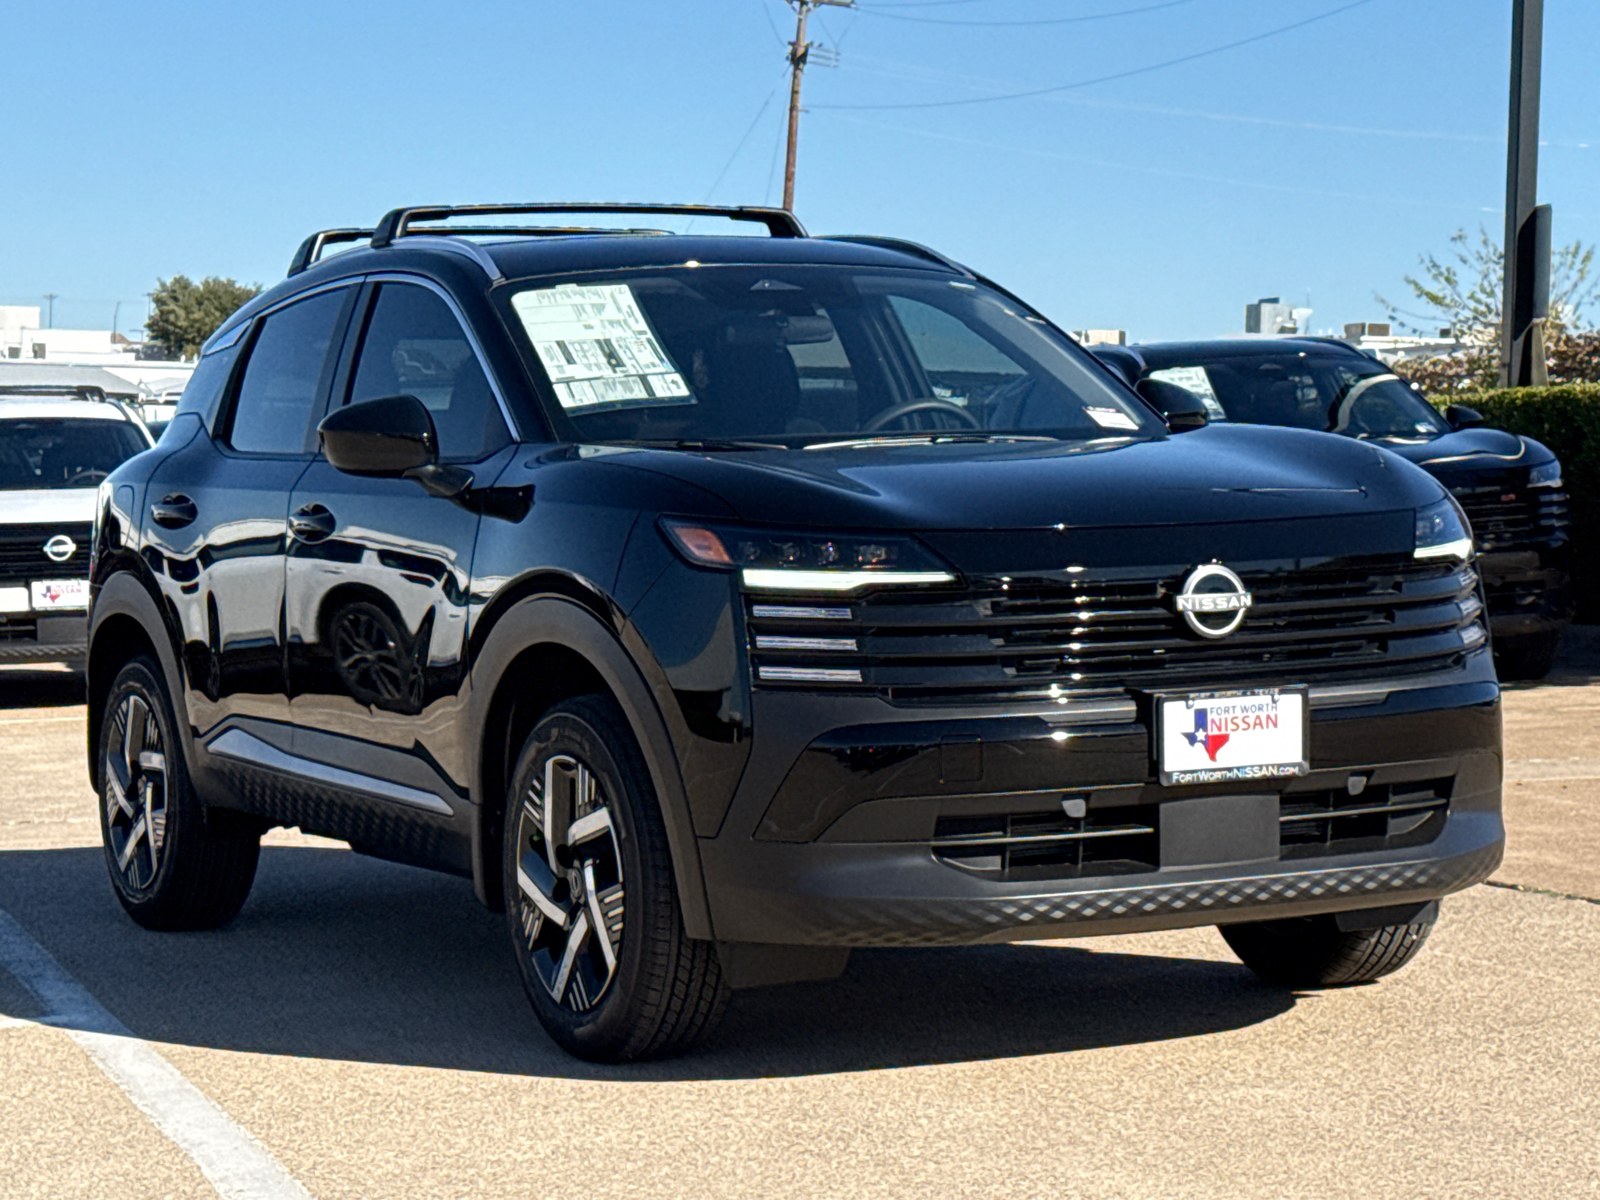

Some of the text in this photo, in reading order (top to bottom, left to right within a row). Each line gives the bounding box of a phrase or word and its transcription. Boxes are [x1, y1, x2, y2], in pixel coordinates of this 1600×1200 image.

[1178, 593, 1252, 610] NISSAN
[1210, 703, 1278, 716] FORT WORTH
[1210, 713, 1278, 733] NISSAN
